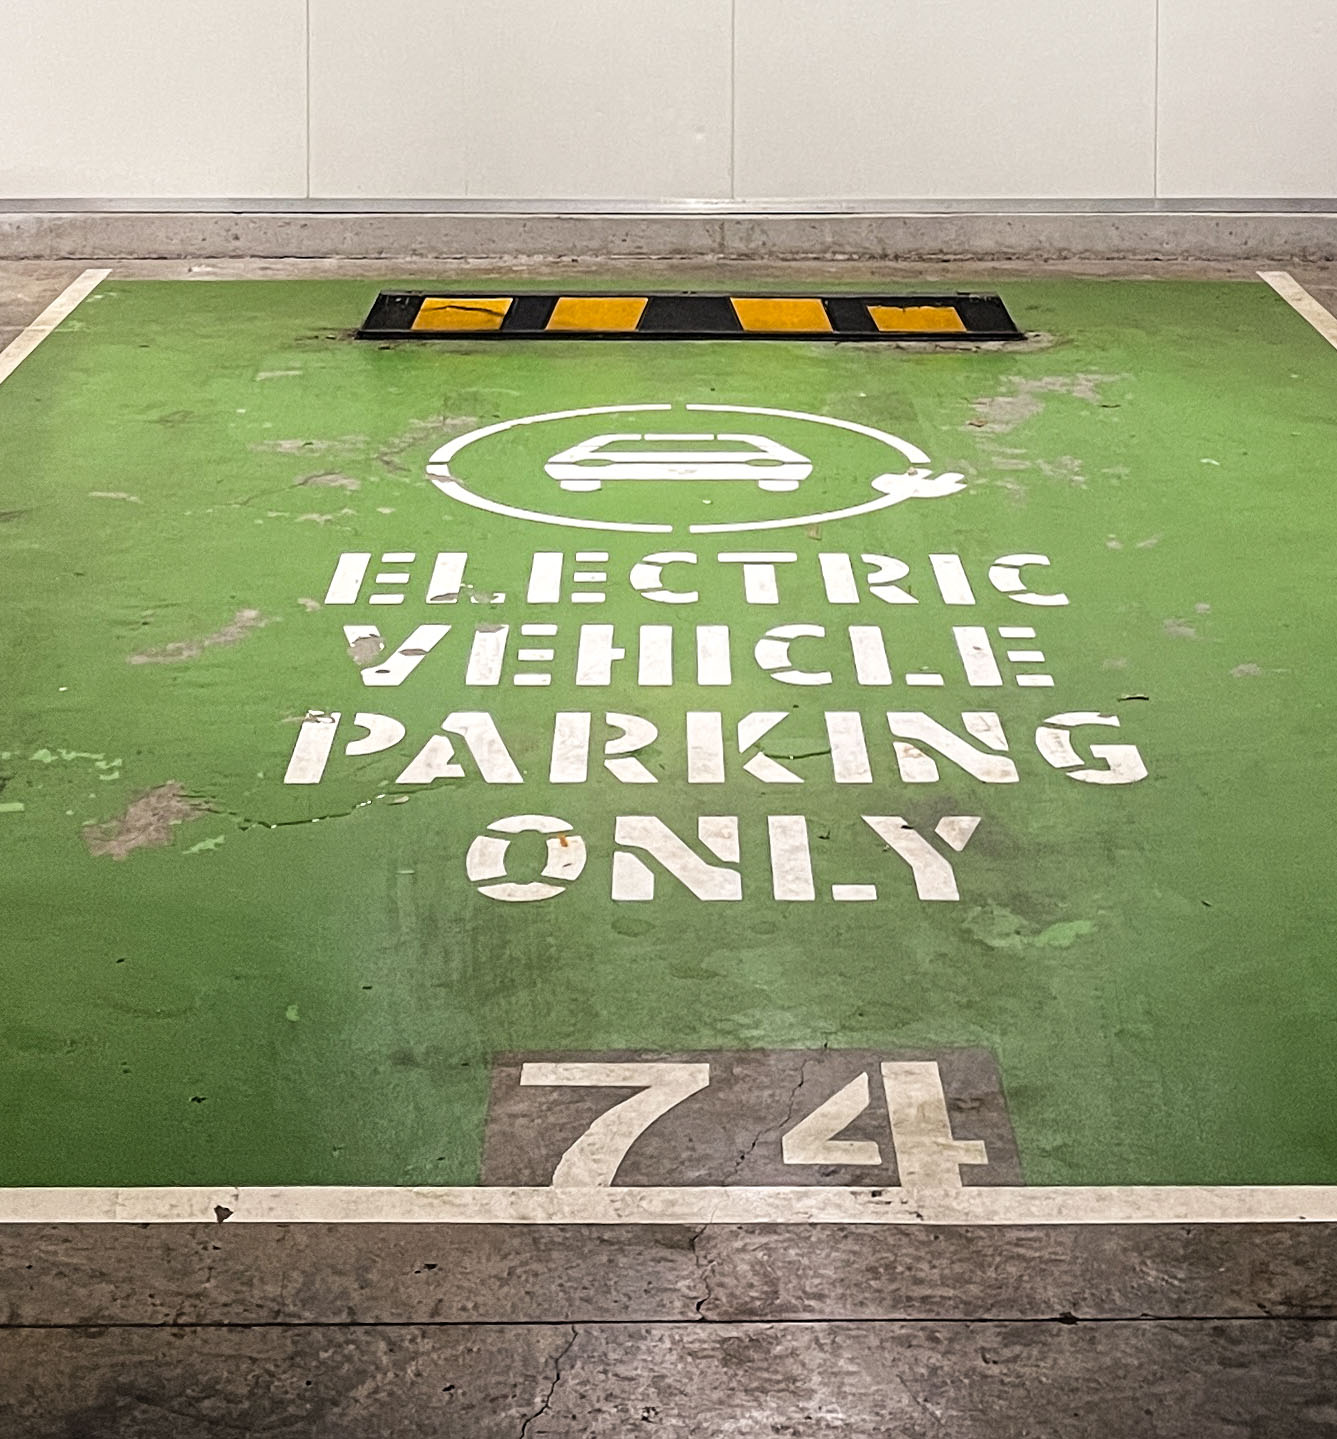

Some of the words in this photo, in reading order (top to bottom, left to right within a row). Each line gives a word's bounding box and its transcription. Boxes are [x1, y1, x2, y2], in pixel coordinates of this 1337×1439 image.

[324, 551, 1070, 606] ELECTRIC
[342, 623, 1055, 687] VEHICLE
[283, 710, 1150, 785] PARKING
[465, 814, 982, 902] ONLY
[519, 1060, 989, 1188] 74
